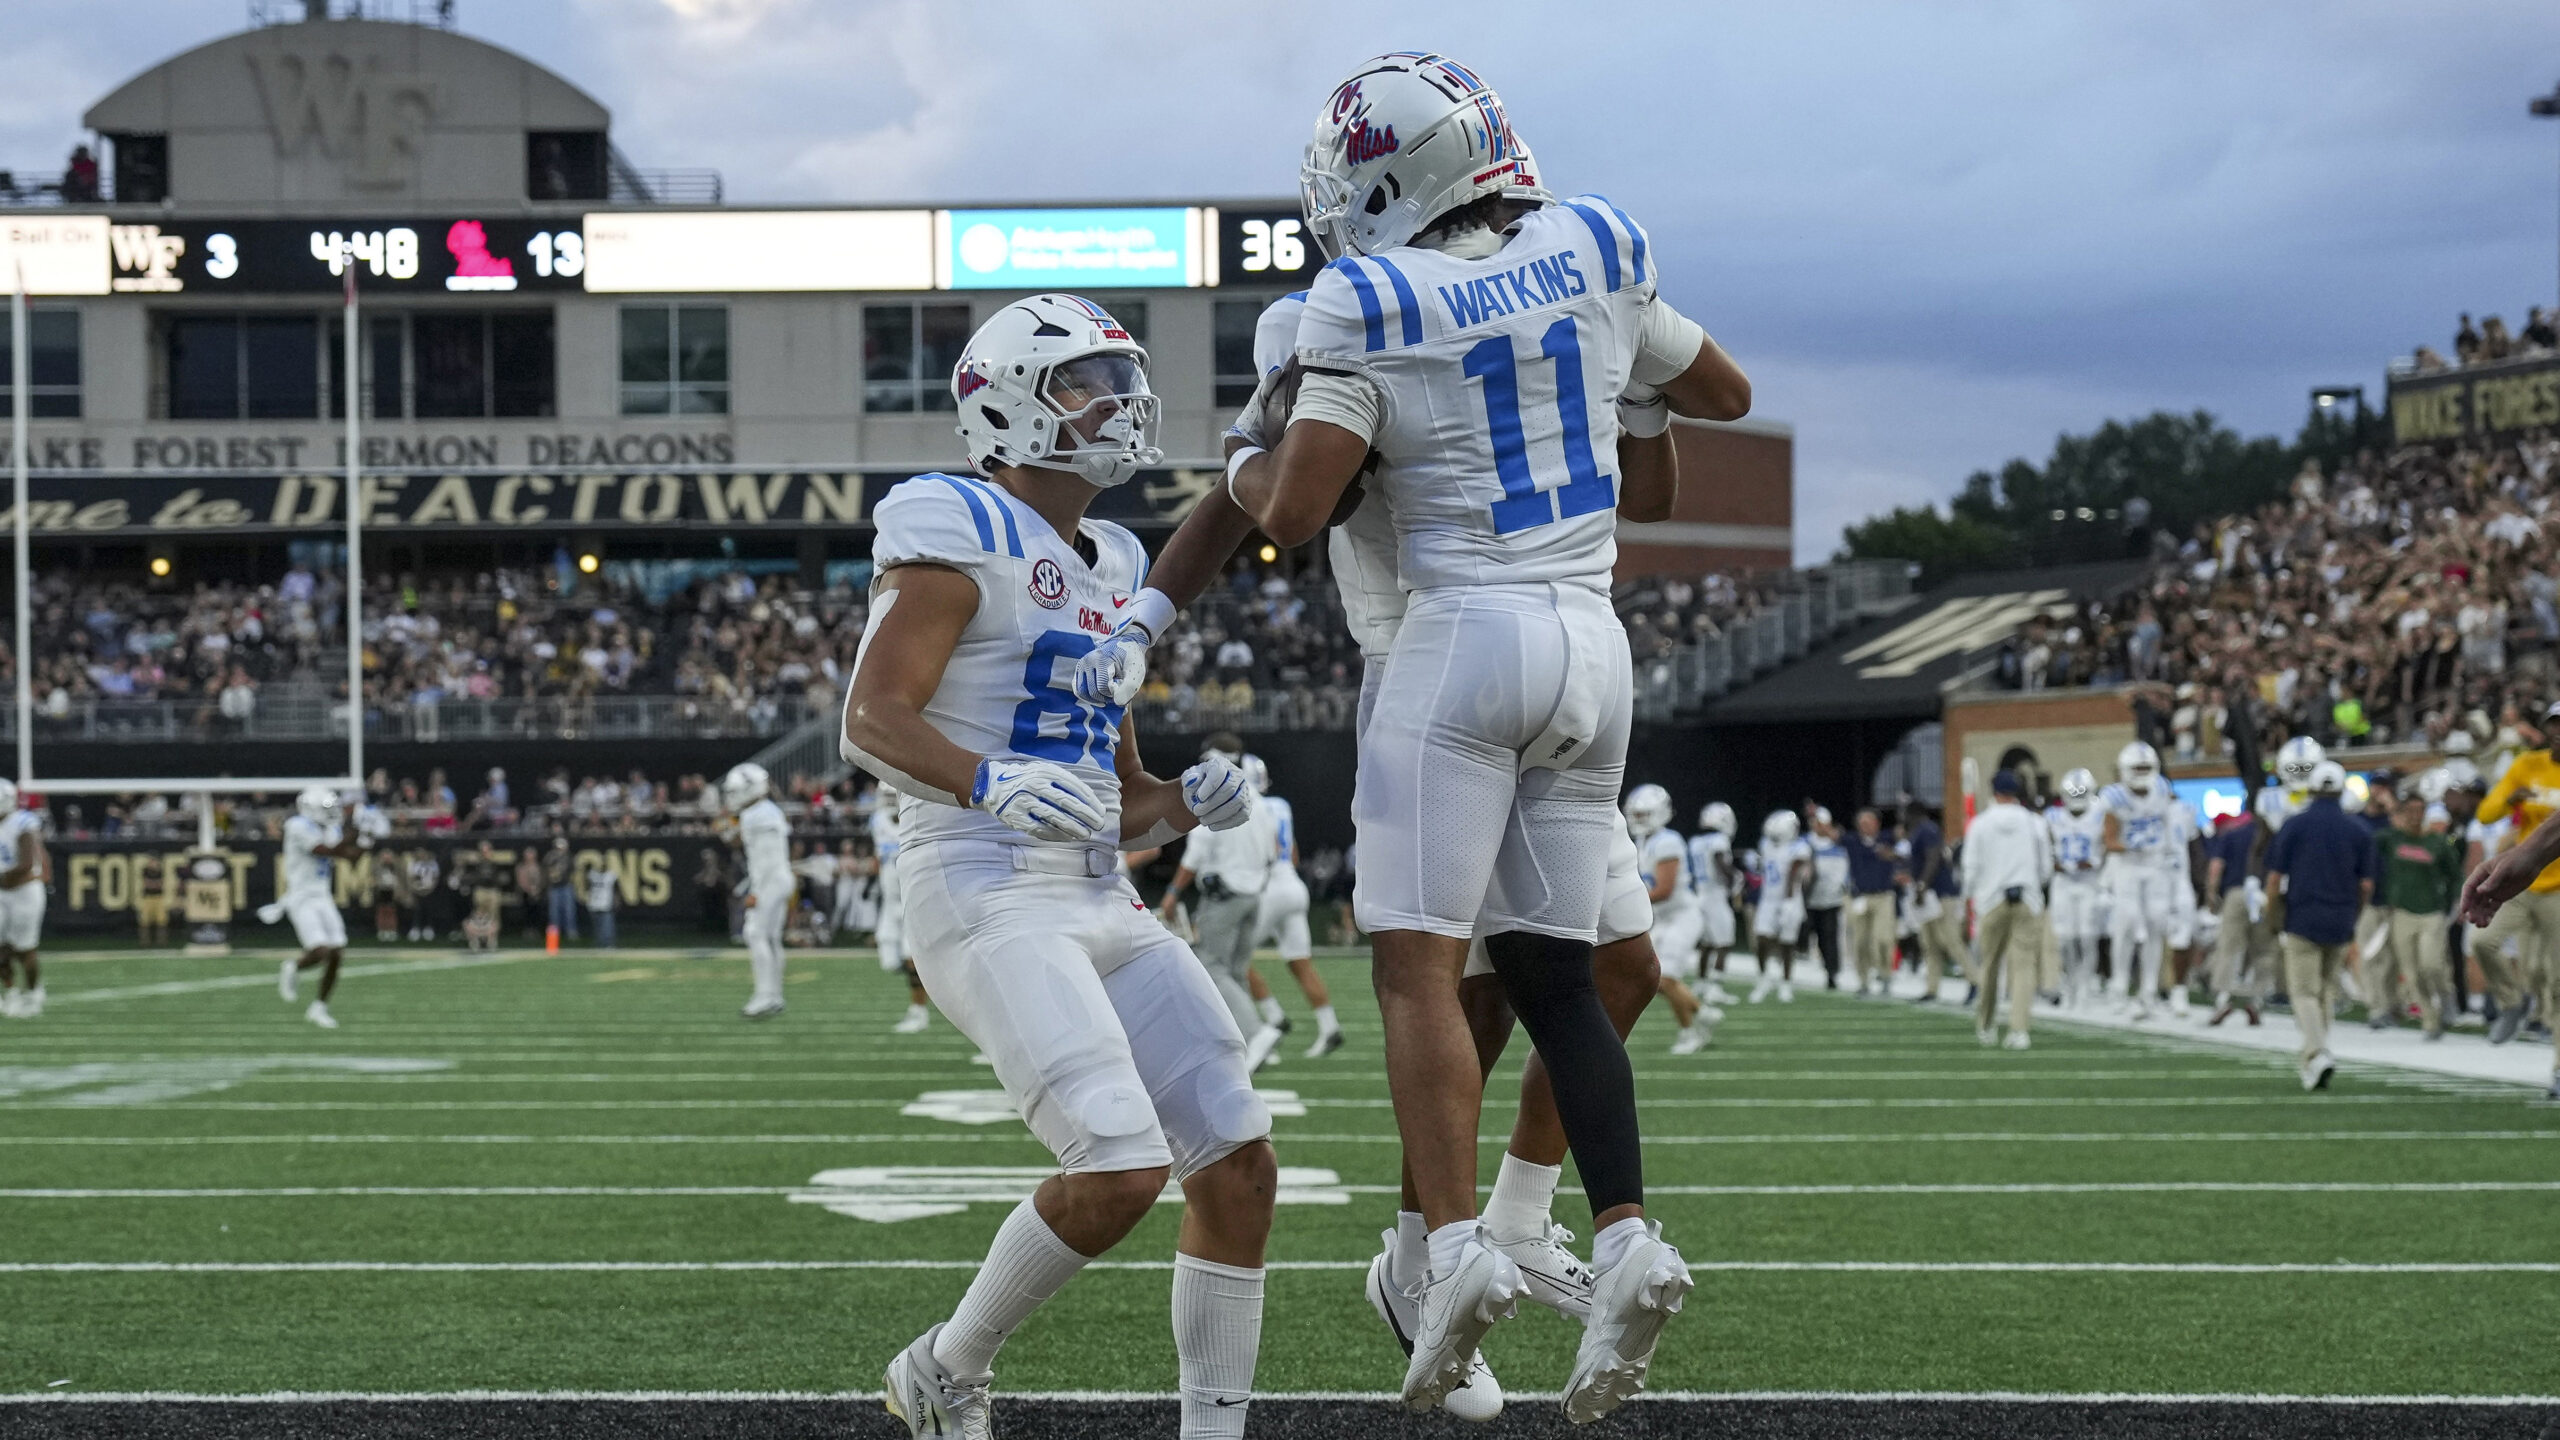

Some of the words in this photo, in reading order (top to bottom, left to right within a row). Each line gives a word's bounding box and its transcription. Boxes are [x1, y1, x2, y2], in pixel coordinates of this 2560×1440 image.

[206, 233, 239, 279] 3
[310, 228, 418, 279] 4:48
[527, 231, 585, 277] 13
[1242, 219, 1304, 271] 36
[1438, 250, 1586, 329] WATKINS
[1462, 316, 1615, 535] 11
[133, 436, 307, 468] FOREST
[528, 433, 735, 465] DEACONS
[270, 472, 864, 528] DEACTOWN
[1033, 591, 1067, 608] GRADUATE
[1036, 561, 1061, 598] SEC
[1079, 607, 1093, 632] Ole
